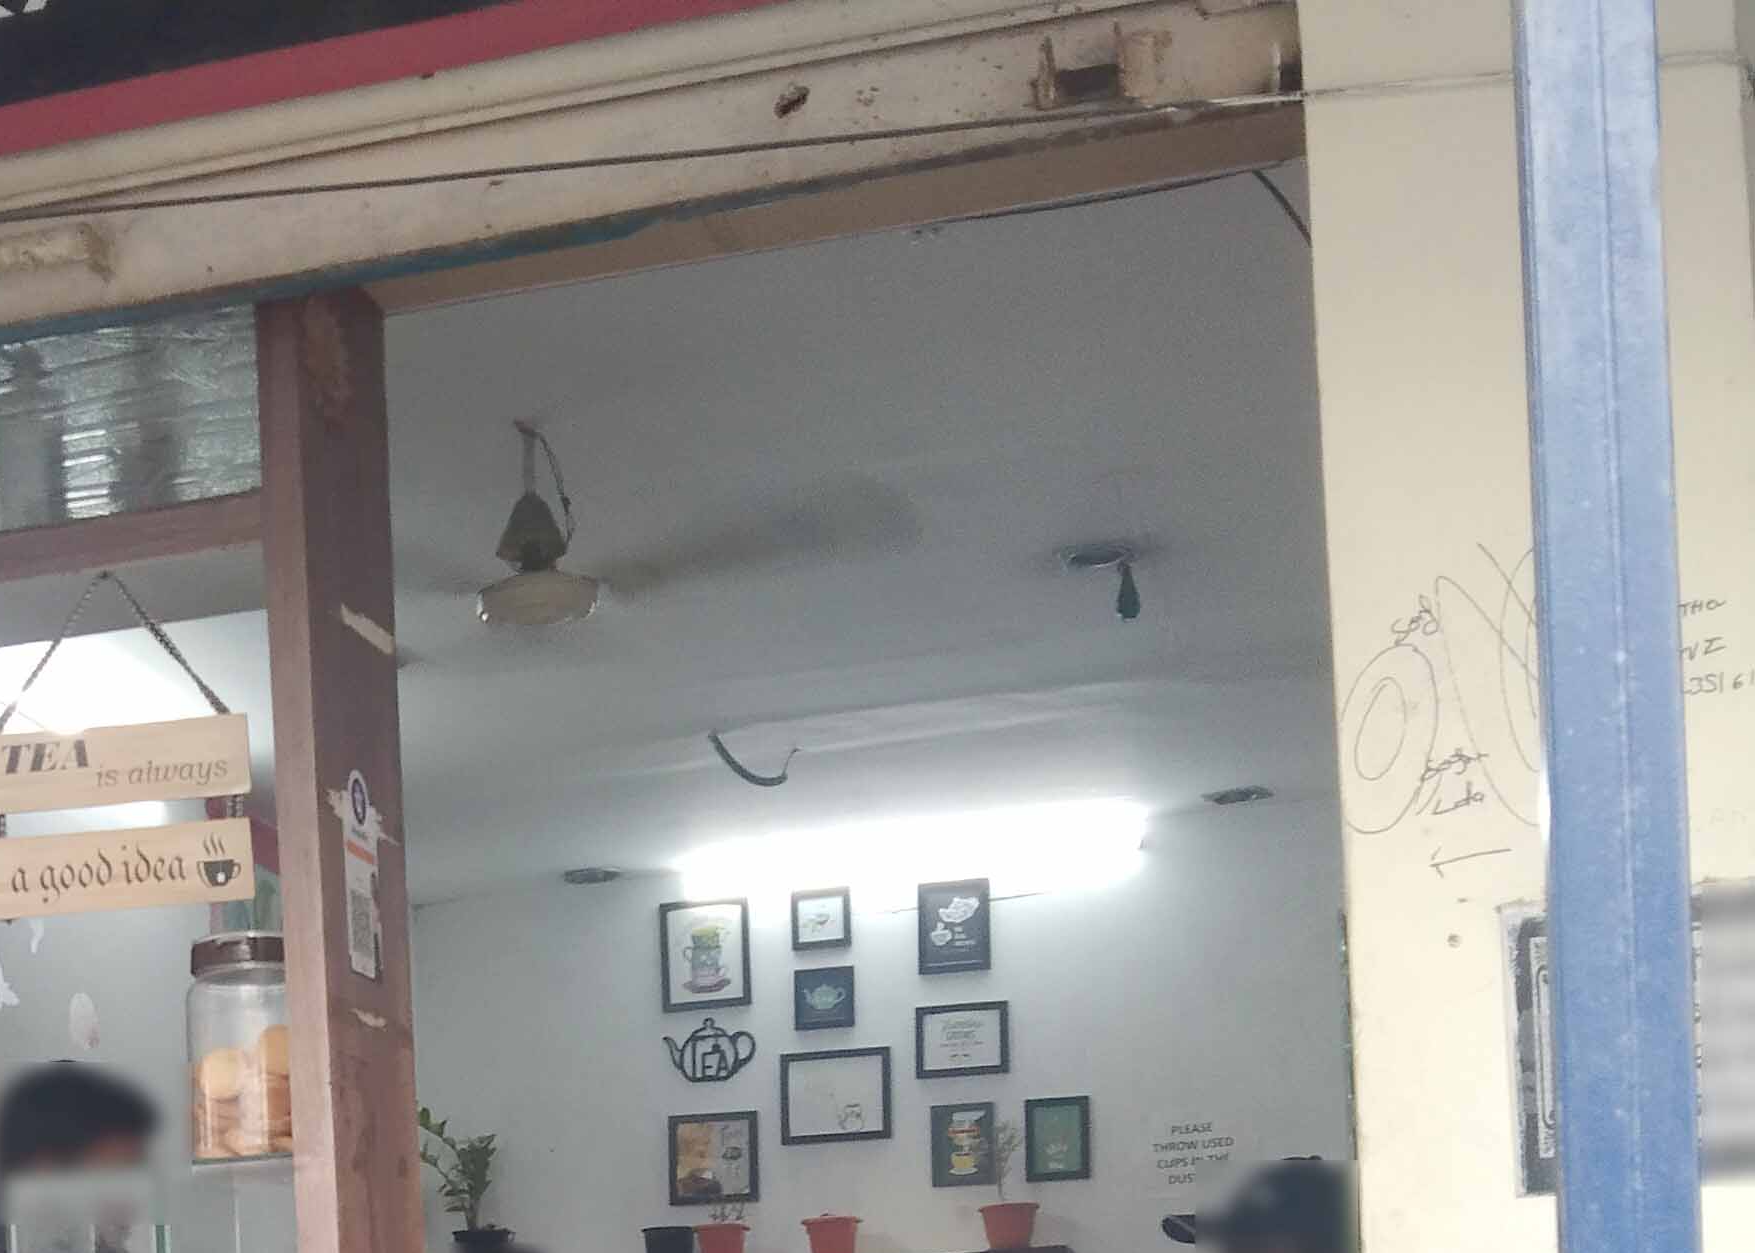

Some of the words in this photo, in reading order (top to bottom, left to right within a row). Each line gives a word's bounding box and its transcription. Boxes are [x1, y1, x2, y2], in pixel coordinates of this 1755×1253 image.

[2, 739, 89, 774] TEA
[95, 764, 120, 788] is
[128, 758, 230, 786] always
[11, 867, 30, 893] a
[39, 849, 114, 904] good
[121, 842, 187, 886] idea
[1151, 1140, 1197, 1153] THROW
[1202, 1136, 1234, 1149] USED
[1171, 1122, 1213, 1135] PLEASE
